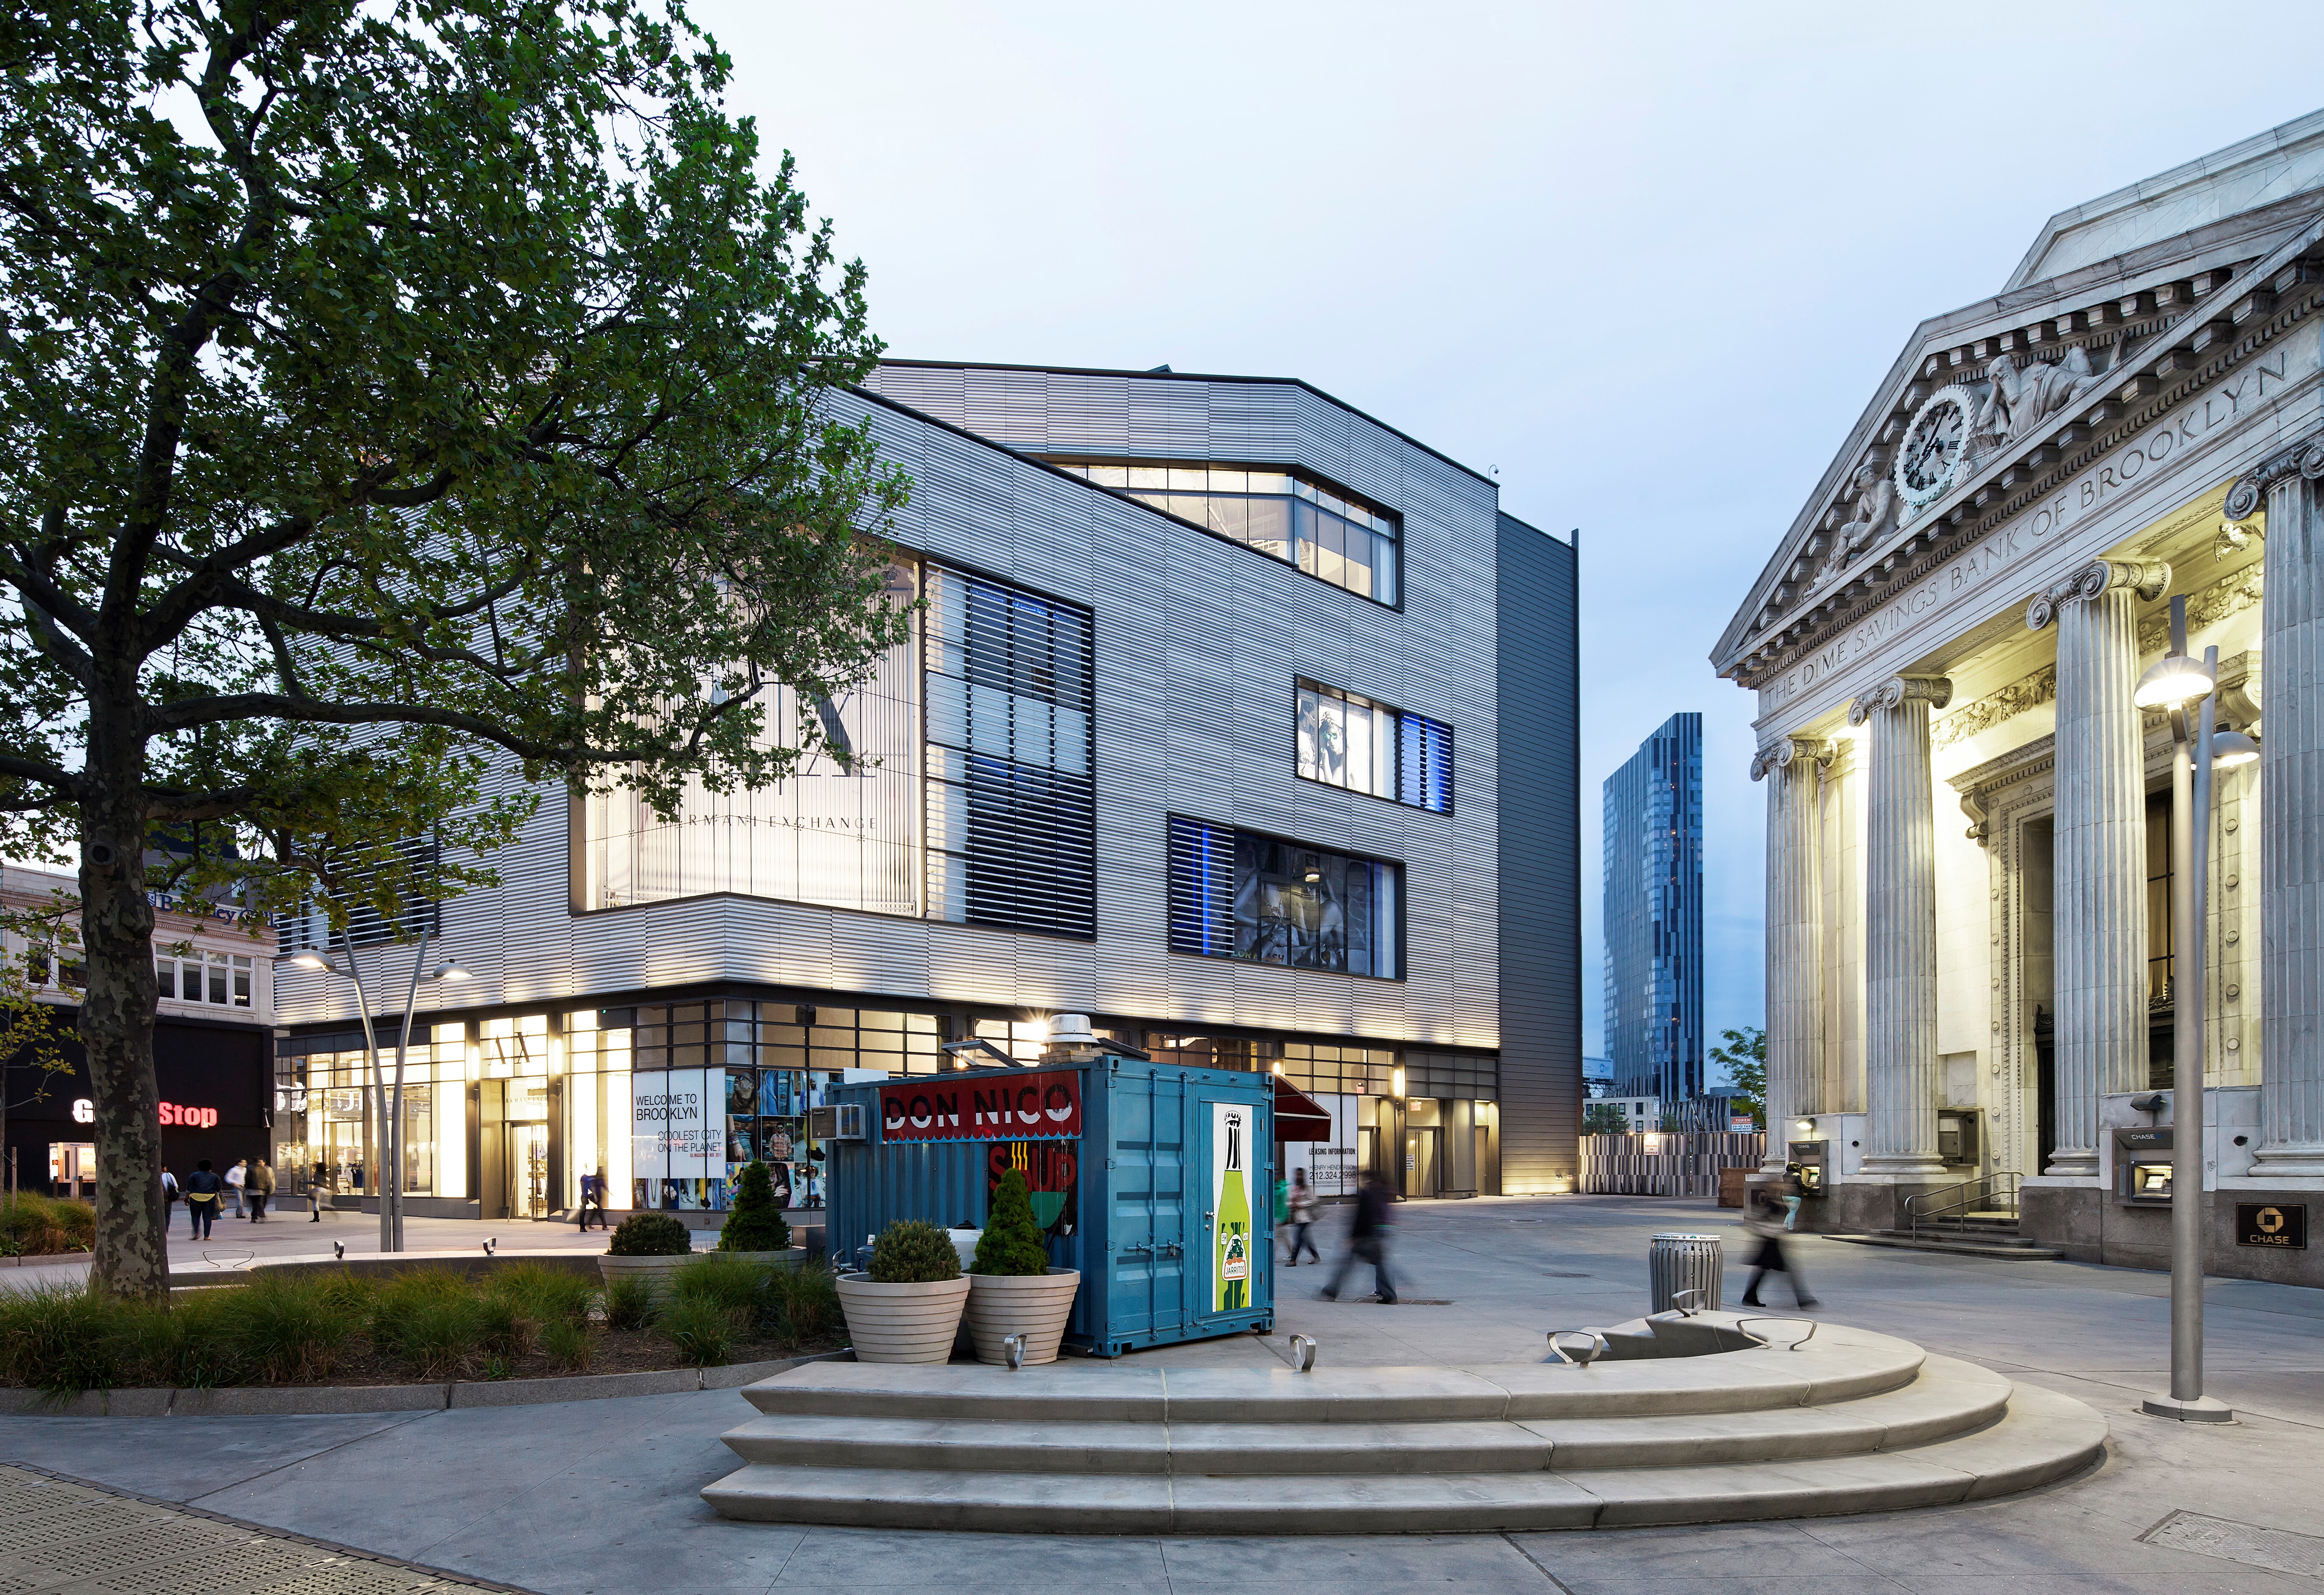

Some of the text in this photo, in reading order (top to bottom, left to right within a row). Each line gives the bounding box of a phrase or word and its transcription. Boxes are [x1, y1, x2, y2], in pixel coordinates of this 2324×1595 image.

[1766, 351, 2286, 708] THE DIME SAVINGS BANK OF BROOKLYN
[688, 814, 876, 829] RMANI EXCHANGE
[636, 1094, 697, 1105] WELCOME TO
[885, 1084, 1072, 1129] DON NICO
[73, 1099, 217, 1128] GStop
[637, 1107, 697, 1120] BROOKLYN
[658, 1130, 722, 1141] COOLEST CITY
[658, 1143, 722, 1152] ON THE PLANET
[1309, 1171, 1356, 1179] 212.324.2998
[2250, 1235, 2290, 1244] CHASE
[1225, 1266, 1245, 1275] JARRITOS
